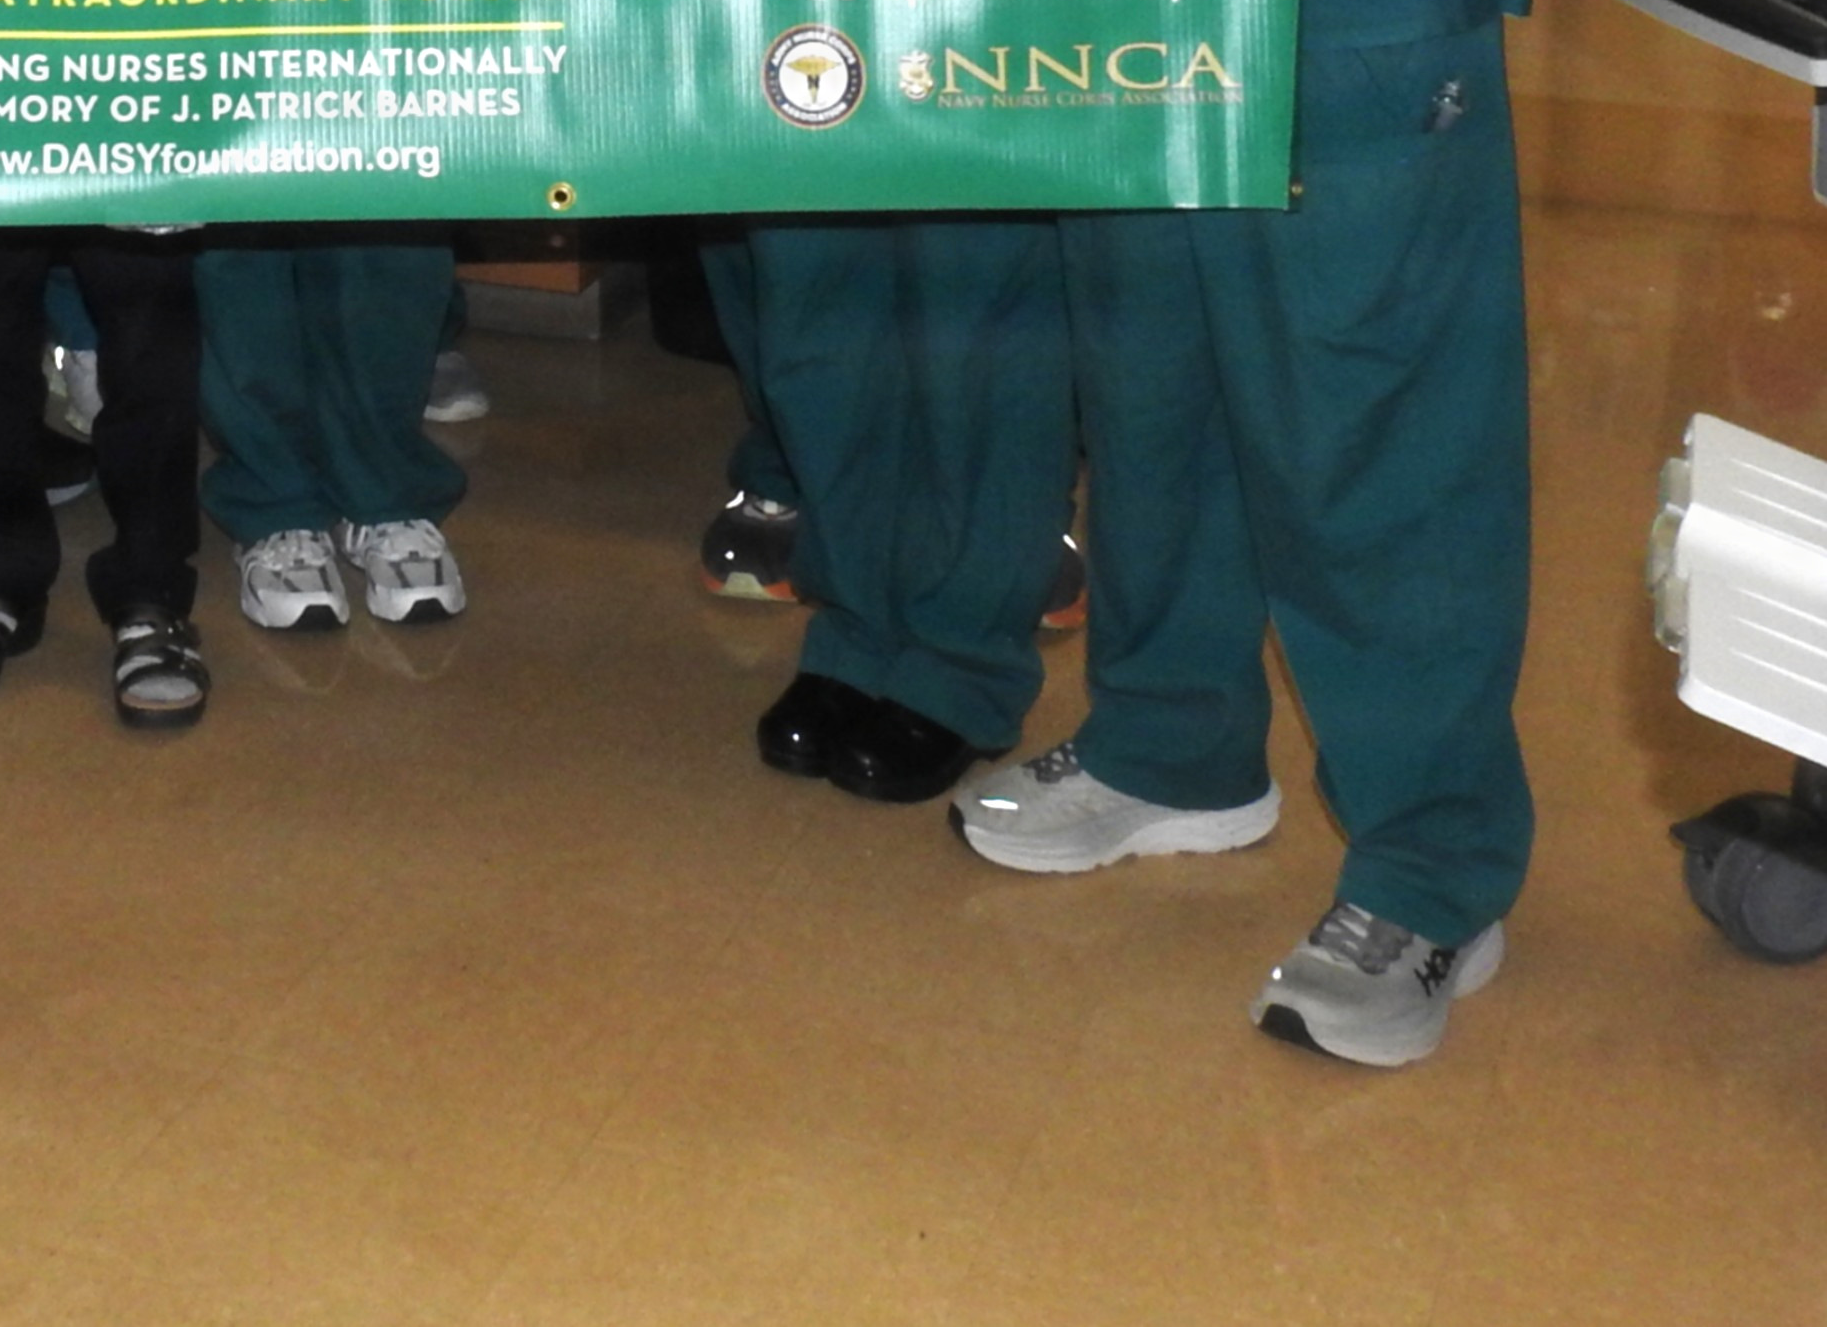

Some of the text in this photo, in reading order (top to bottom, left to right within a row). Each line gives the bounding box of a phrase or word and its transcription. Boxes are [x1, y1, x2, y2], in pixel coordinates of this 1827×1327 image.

[63, 52, 208, 82] NURSES
[219, 45, 568, 80] INTERNATIONALLY
[941, 41, 1244, 93] NNCA
[110, 94, 161, 122] OF
[172, 93, 201, 122] J.
[212, 90, 365, 121] PATRICK
[376, 87, 521, 118] BARNES
